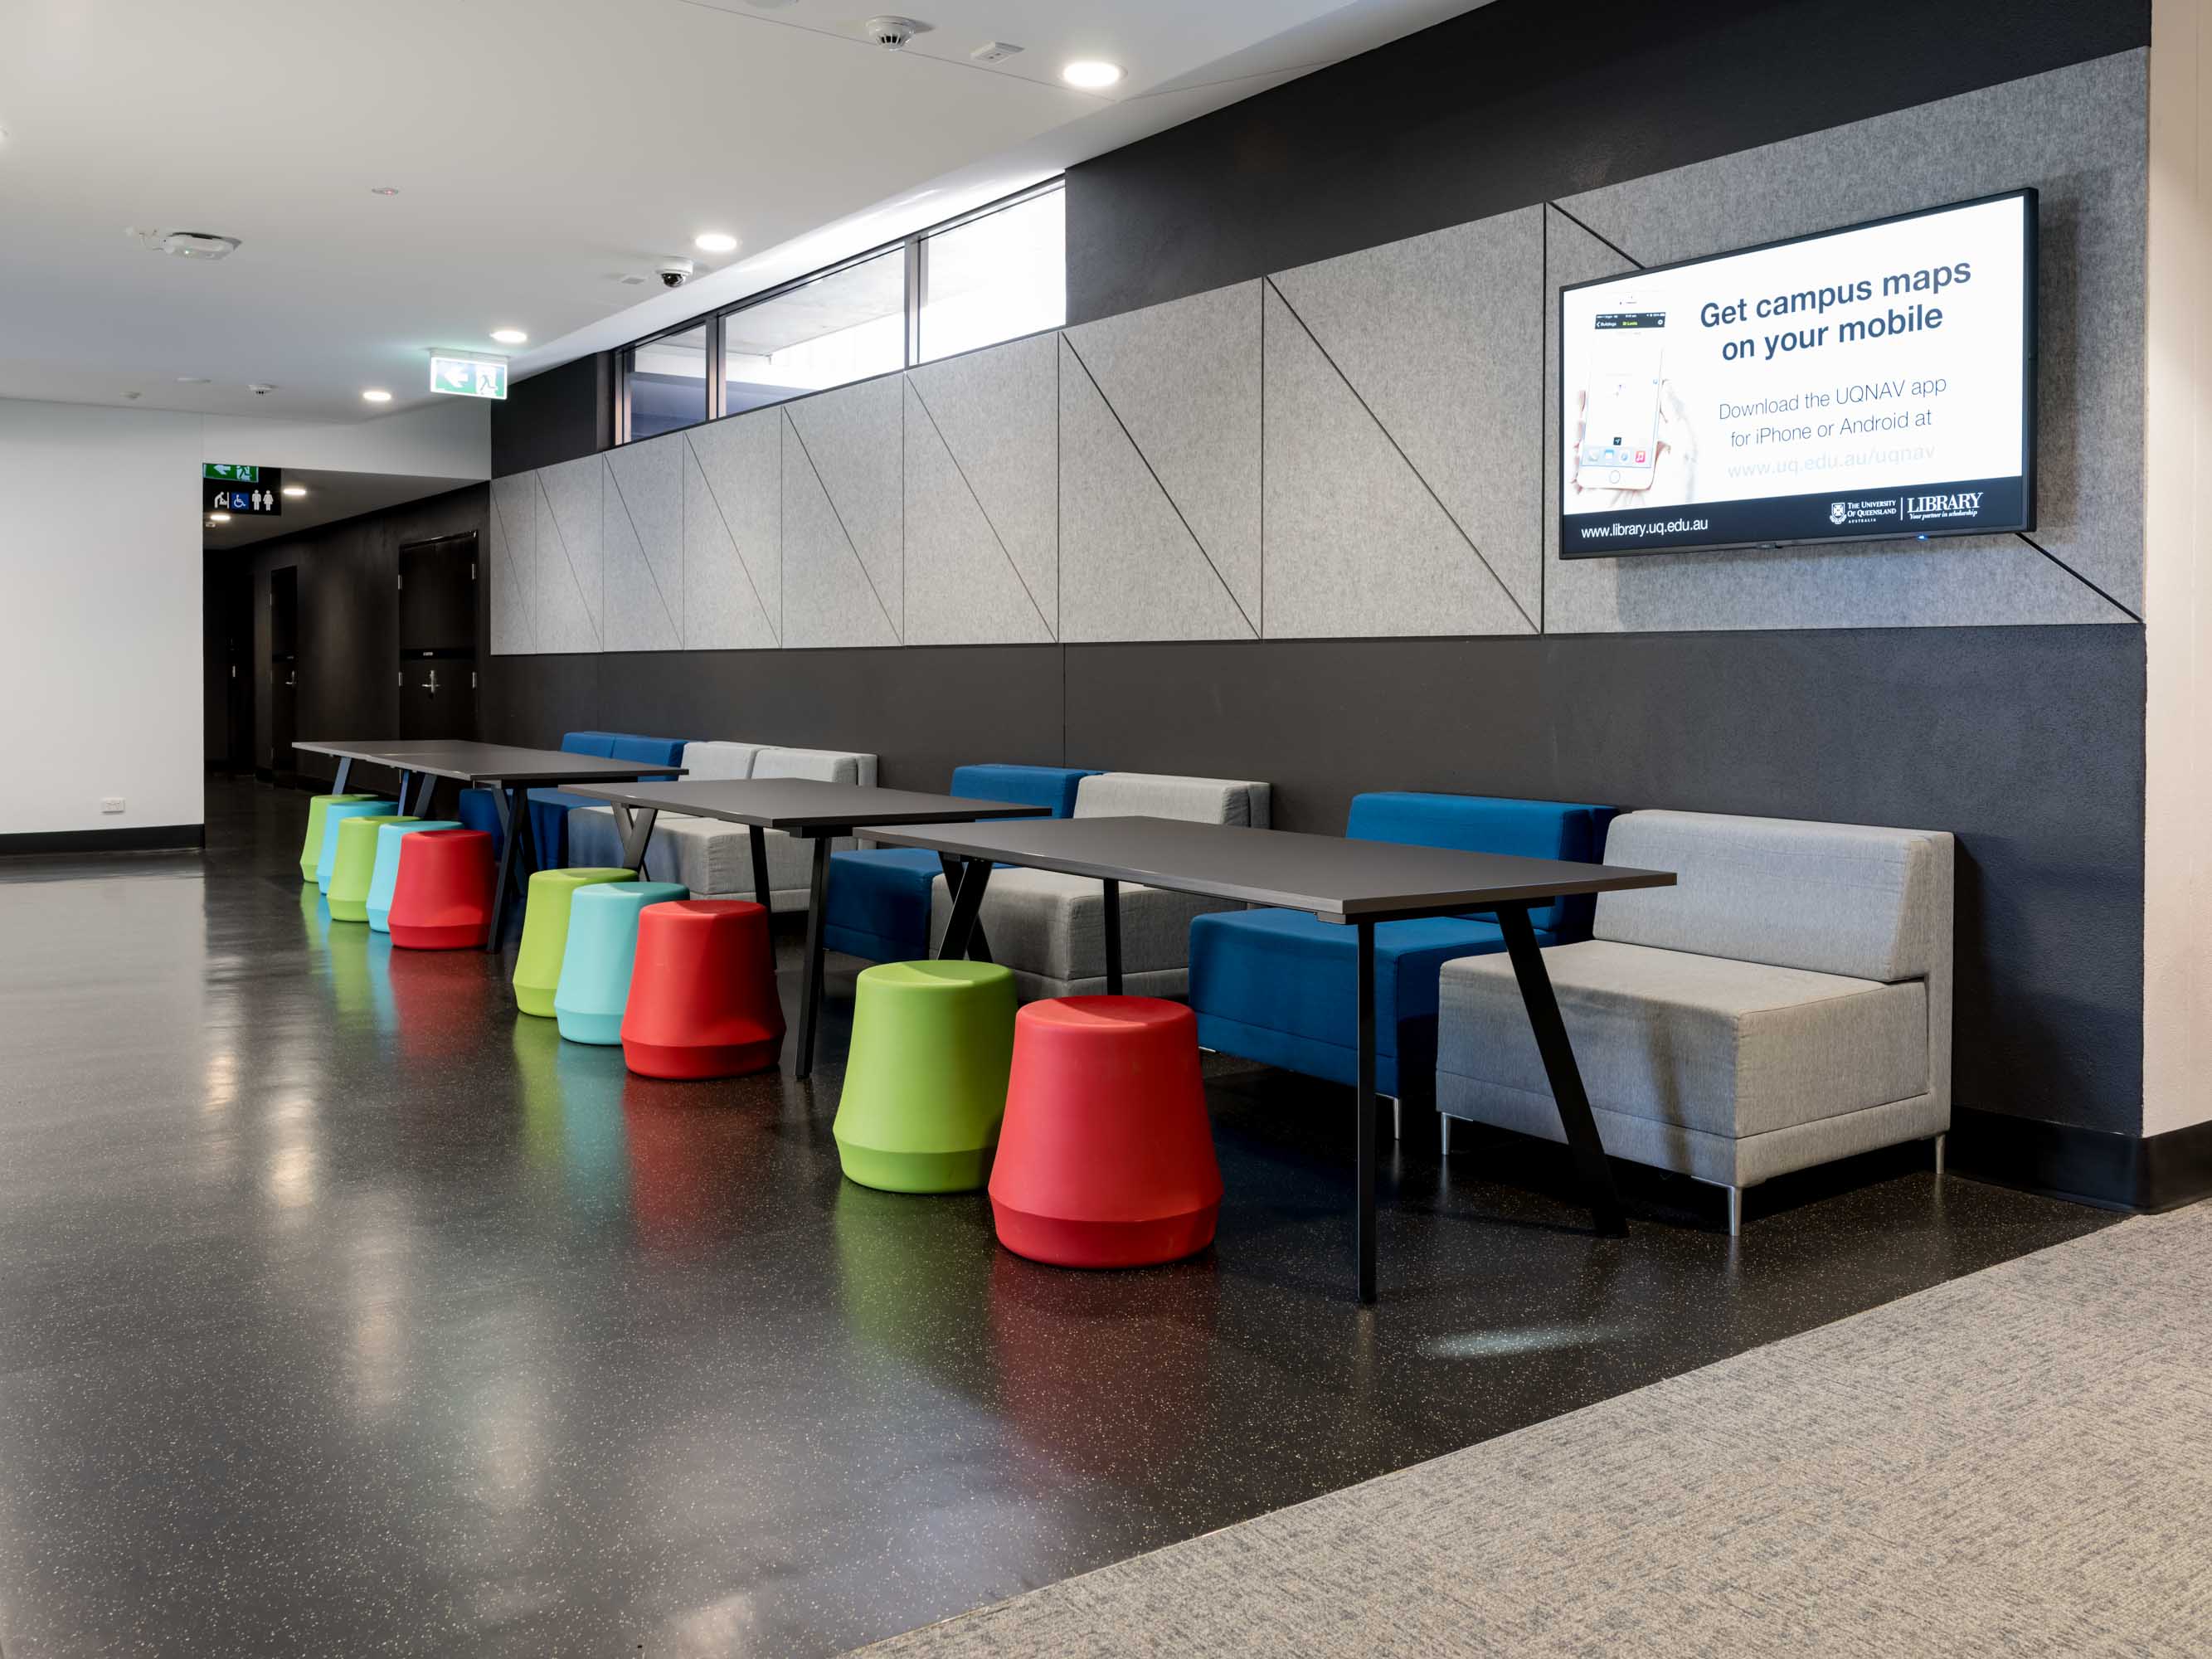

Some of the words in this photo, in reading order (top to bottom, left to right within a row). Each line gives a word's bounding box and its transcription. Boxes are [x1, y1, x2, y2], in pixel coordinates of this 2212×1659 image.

[1700, 298, 1748, 328] Get
[1756, 280, 1873, 318] campus
[1883, 261, 1971, 296] maps
[1722, 338, 1755, 361] on
[1764, 326, 1829, 361] your
[1839, 304, 1943, 343] mobile
[1719, 394, 1799, 420] Download
[1805, 392, 1830, 409] the
[1836, 379, 1906, 405] UQNAV
[1911, 378, 1947, 397] app
[1731, 431, 1752, 448] for
[1755, 426, 1811, 445] iPhone
[1816, 423, 1835, 439] or
[1839, 411, 1909, 435] Android
[1914, 409, 1932, 428] at
[1727, 445, 1937, 479] www.uq.edu.au/uqnav
[1847, 502, 1860, 510] THE
[1861, 499, 1897, 508] UNIVERSITY
[1858, 508, 1897, 518] QUEENSLAND
[1907, 492, 1984, 513] LIBRARY
[1581, 518, 1709, 538] www.library.uq.edu.au
[1922, 512, 1941, 521] partner
